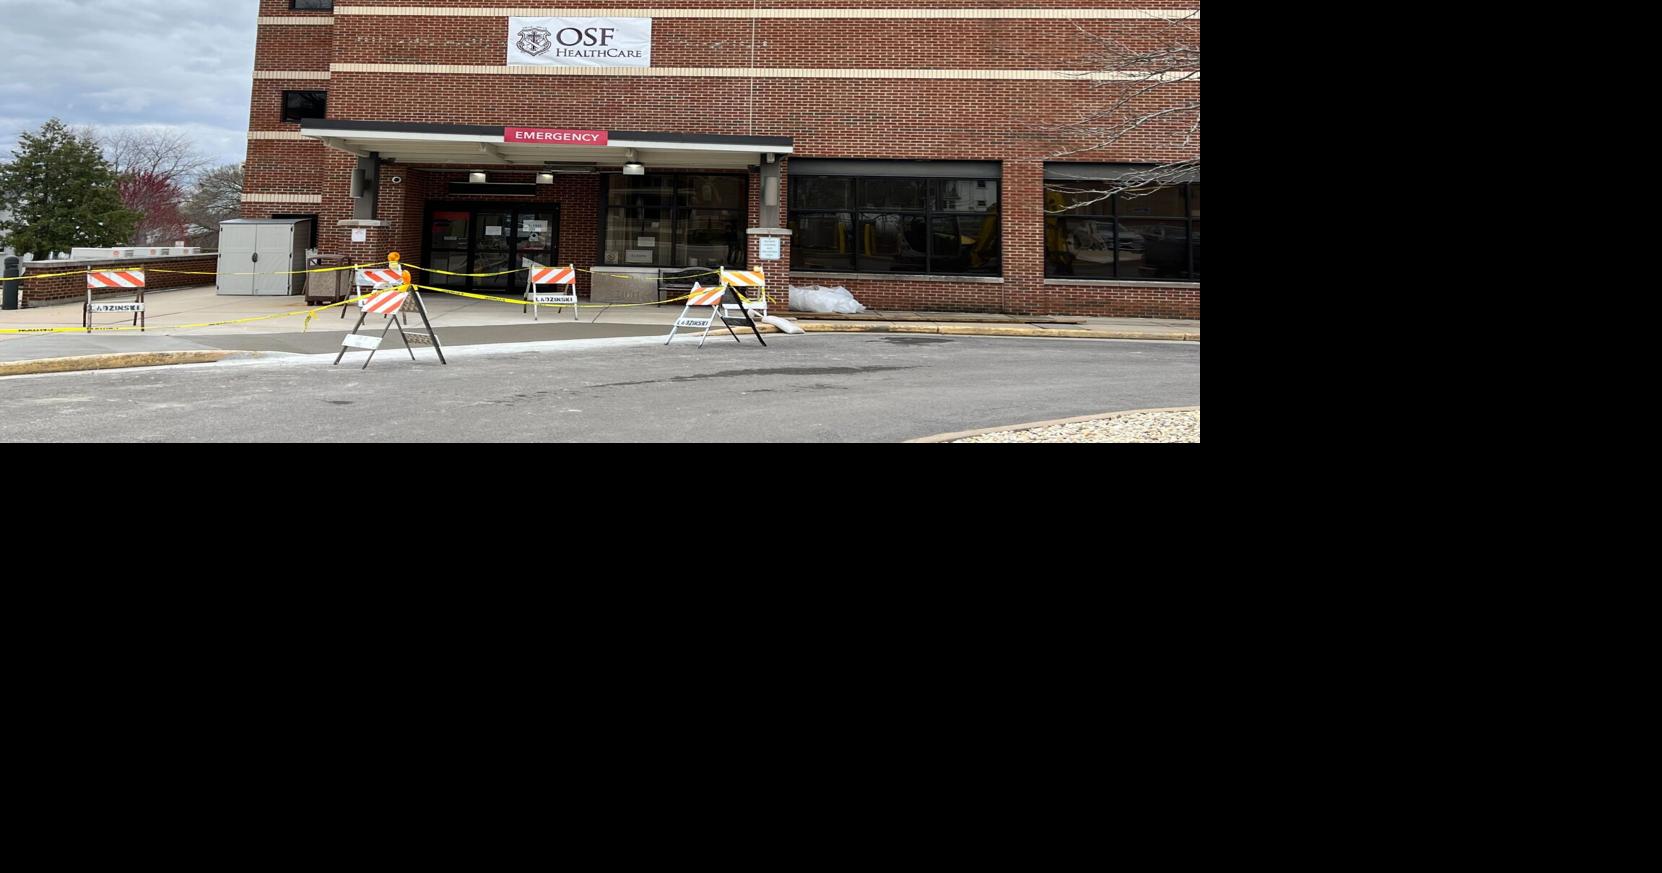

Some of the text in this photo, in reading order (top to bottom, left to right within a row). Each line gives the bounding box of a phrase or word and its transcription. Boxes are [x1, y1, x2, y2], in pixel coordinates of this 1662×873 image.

[556, 27, 615, 47] OSF
[556, 48, 642, 58] HEALTHCARE
[514, 131, 599, 142] EMERGENCY
